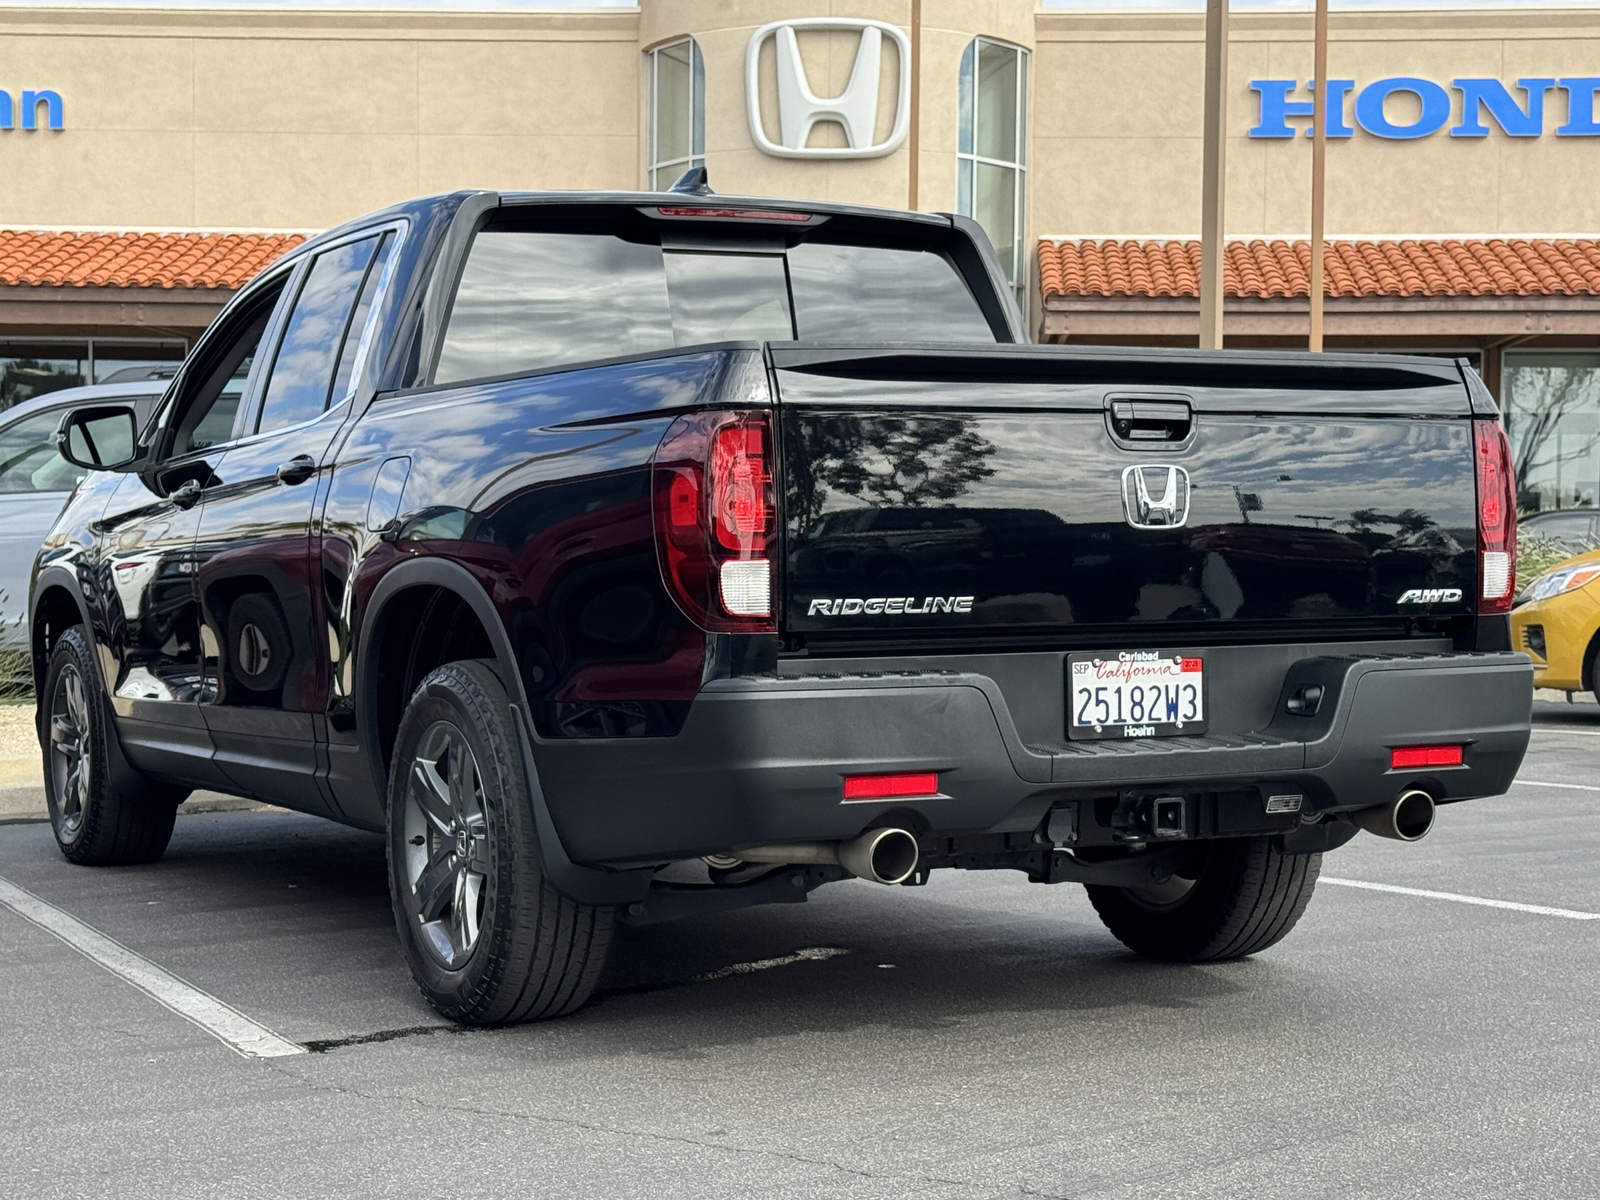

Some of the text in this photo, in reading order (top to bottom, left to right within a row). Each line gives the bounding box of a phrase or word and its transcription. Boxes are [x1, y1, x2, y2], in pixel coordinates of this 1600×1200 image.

[1396, 588, 1463, 604] AWD
[807, 596, 975, 616] RIDGELINE
[1118, 651, 1159, 662] Carlsbad
[1073, 663, 1090, 675] SEP
[1096, 660, 1181, 684] California
[1077, 683, 1197, 725] 25182W3
[1124, 724, 1156, 737] Hoehn
